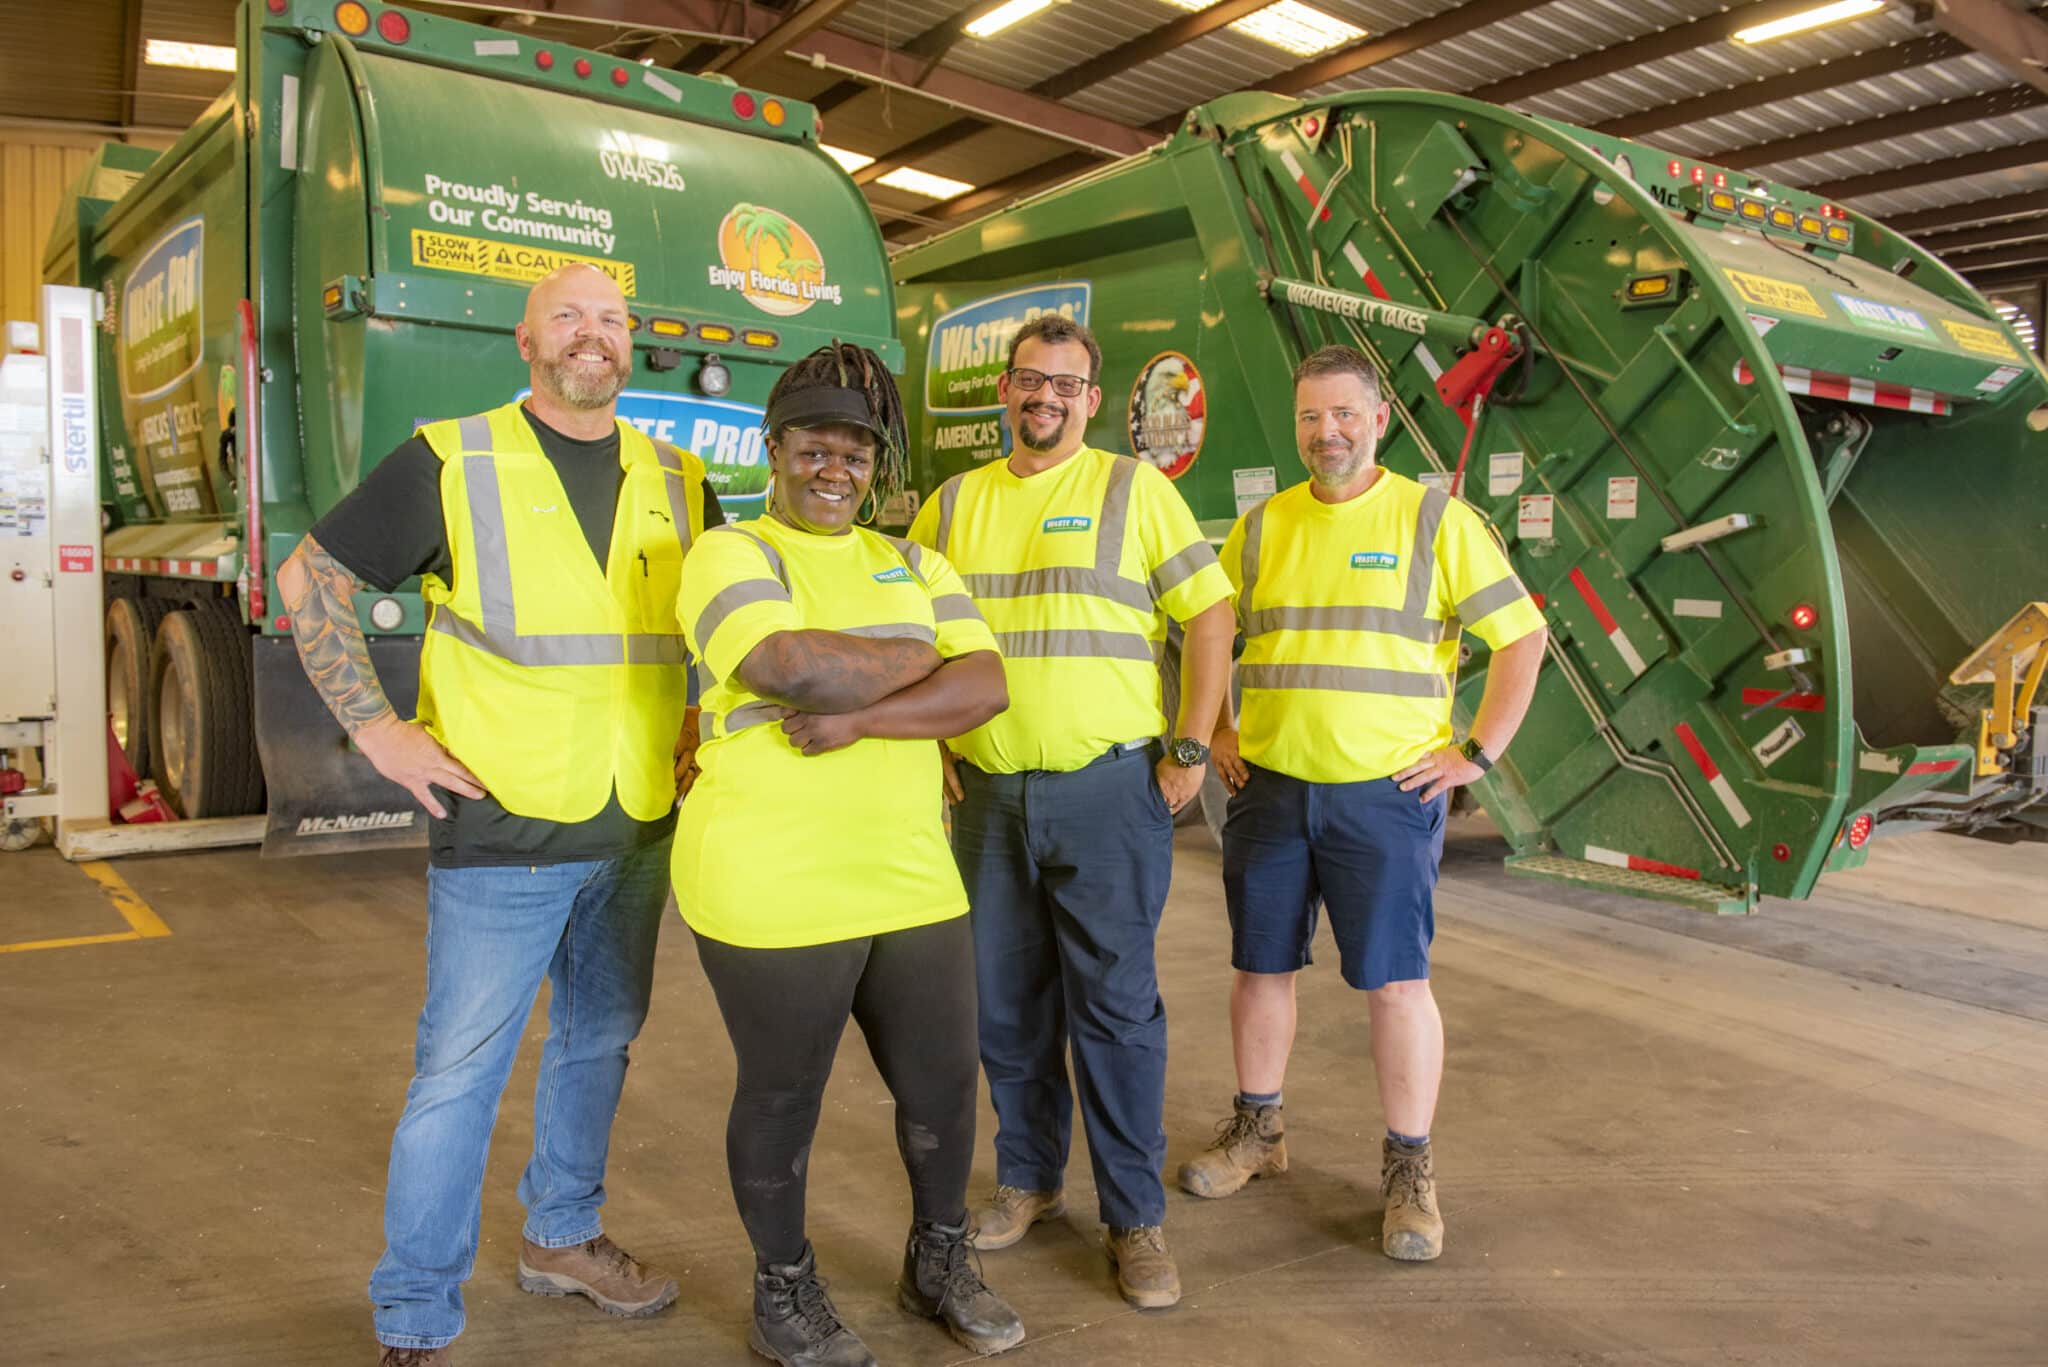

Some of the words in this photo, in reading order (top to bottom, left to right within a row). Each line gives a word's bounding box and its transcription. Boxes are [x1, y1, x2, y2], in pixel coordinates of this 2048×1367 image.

[601, 150, 686, 192] 0144526
[425, 174, 519, 213] Proudly
[525, 192, 613, 229] Serving
[428, 201, 475, 226] Our
[481, 209, 616, 254] Community
[428, 235, 469, 250] SLOW
[426, 247, 475, 262] DOWN
[708, 265, 746, 291] Enjoy
[750, 268, 799, 297] Florida
[801, 281, 843, 305] Living
[1287, 284, 1360, 319] WHATEVER
[1362, 300, 1377, 323] IT
[1380, 305, 1429, 335] TAKES
[64, 397, 88, 473] stertil
[689, 417, 763, 467] PRO
[935, 420, 1000, 450] AMERICA'S
